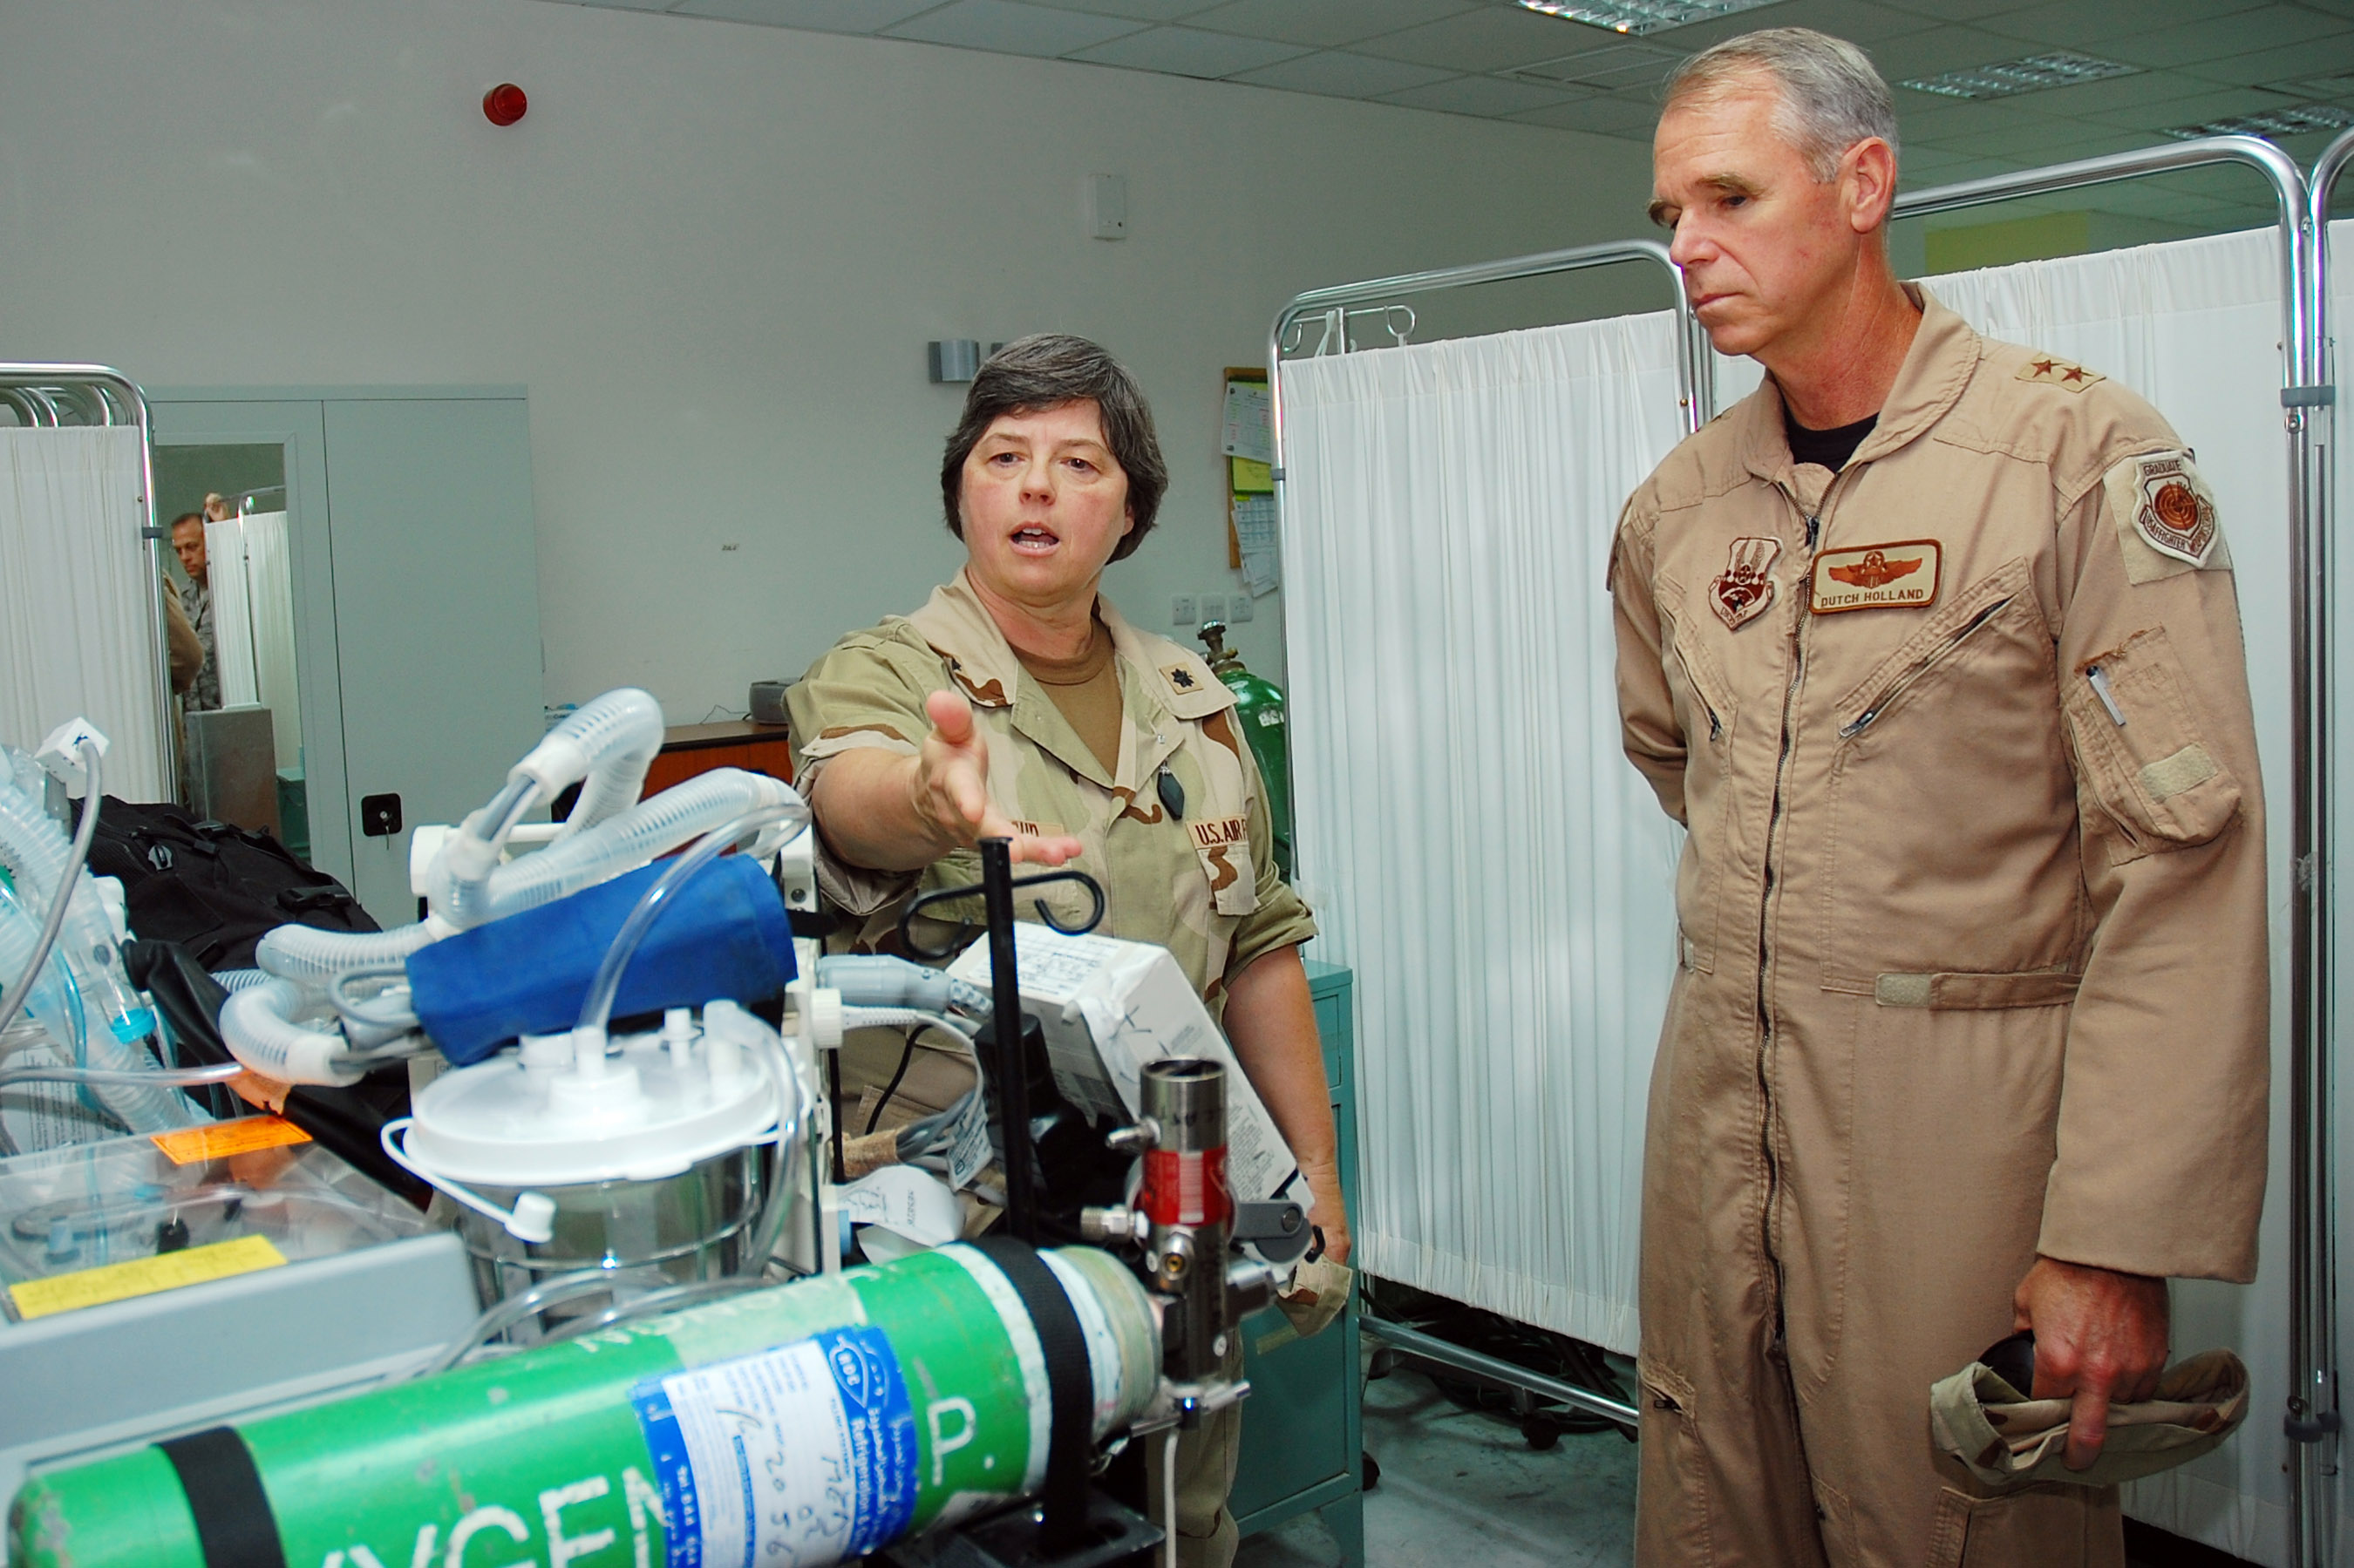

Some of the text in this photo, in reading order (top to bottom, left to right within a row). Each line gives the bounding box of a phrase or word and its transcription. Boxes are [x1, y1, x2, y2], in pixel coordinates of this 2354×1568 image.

[2143, 459, 2182, 476] GRADUATE
[1820, 588, 1923, 608] DUTCH HOLLAND
[1194, 822, 1224, 845] U.S.
[1221, 818, 1242, 843] AIR
[851, 1417, 870, 1514] Refrigeration
[321, 1466, 673, 1568] GEN
